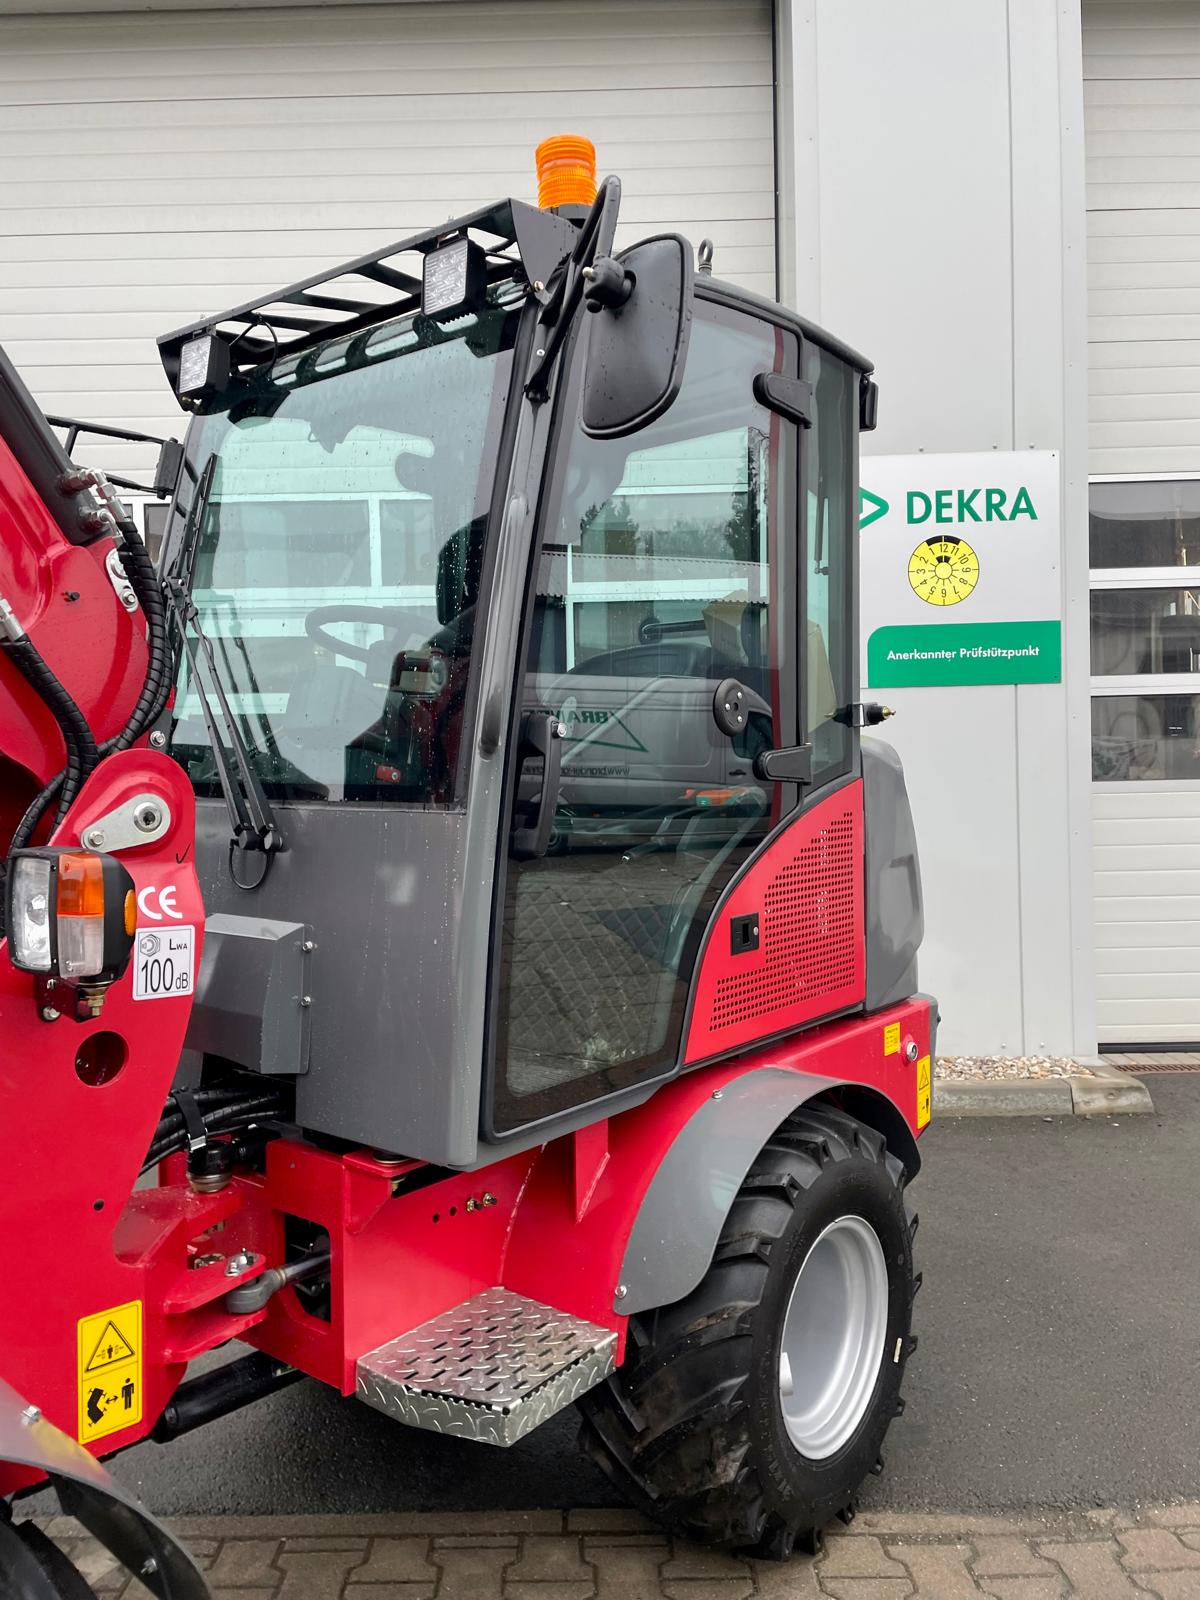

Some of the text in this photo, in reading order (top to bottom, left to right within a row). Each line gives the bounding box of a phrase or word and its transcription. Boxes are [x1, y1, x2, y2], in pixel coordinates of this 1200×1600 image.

[907, 486, 1038, 524] DEKRA
[939, 543, 949, 553] 12
[950, 545, 960, 556] 11
[919, 556, 929, 564] 2
[958, 553, 969, 565] 10
[958, 577, 968, 585] 8
[928, 586, 937, 595] 5
[941, 588, 947, 598] 6
[953, 585, 959, 595] 7
[886, 645, 1039, 660] Anerkannter Prüfstützpunkt
[137, 885, 184, 920] CE
[141, 958, 188, 993] 100 dB
